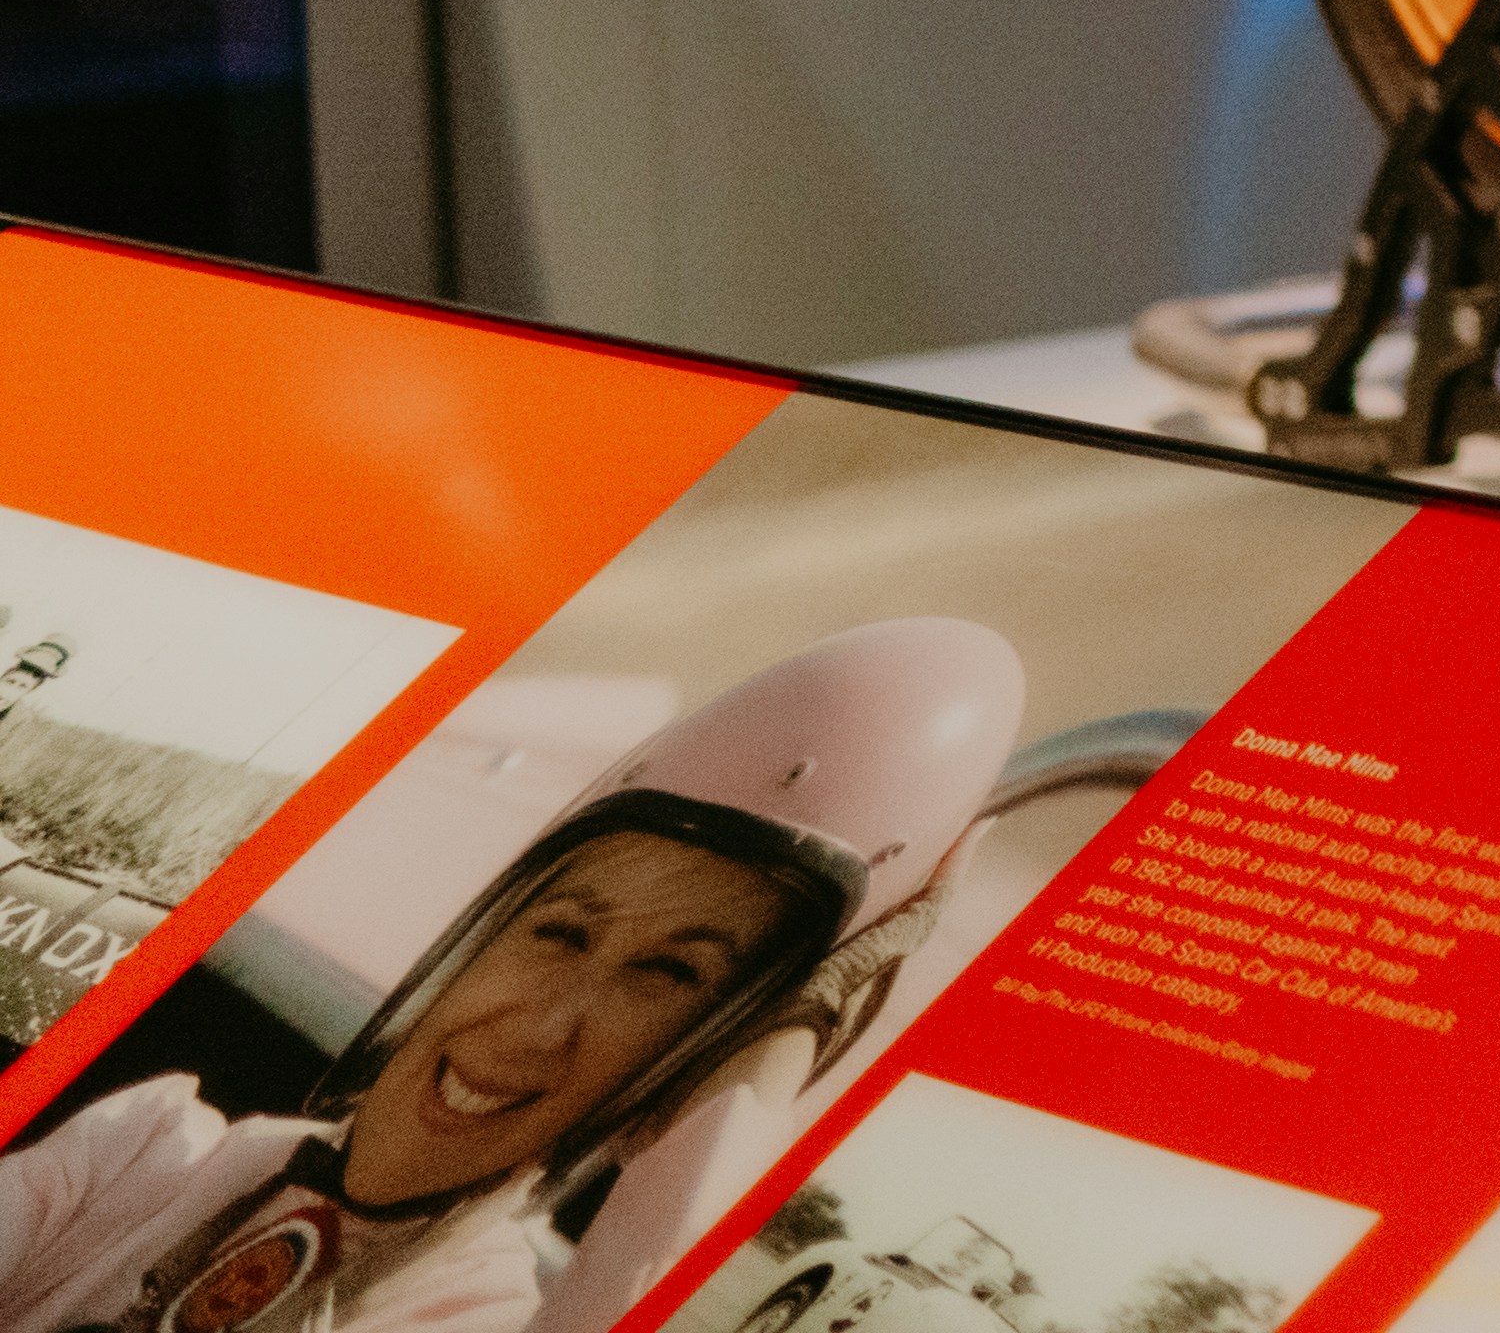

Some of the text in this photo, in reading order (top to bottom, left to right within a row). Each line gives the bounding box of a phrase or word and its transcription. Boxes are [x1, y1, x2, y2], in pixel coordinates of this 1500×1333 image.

[1232, 726, 1299, 759] Donna
[1190, 769, 1257, 802] Donna
[1163, 798, 1189, 819] to
[1222, 815, 1243, 833] a
[1136, 824, 1177, 851] She
[1245, 855, 1265, 873] a
